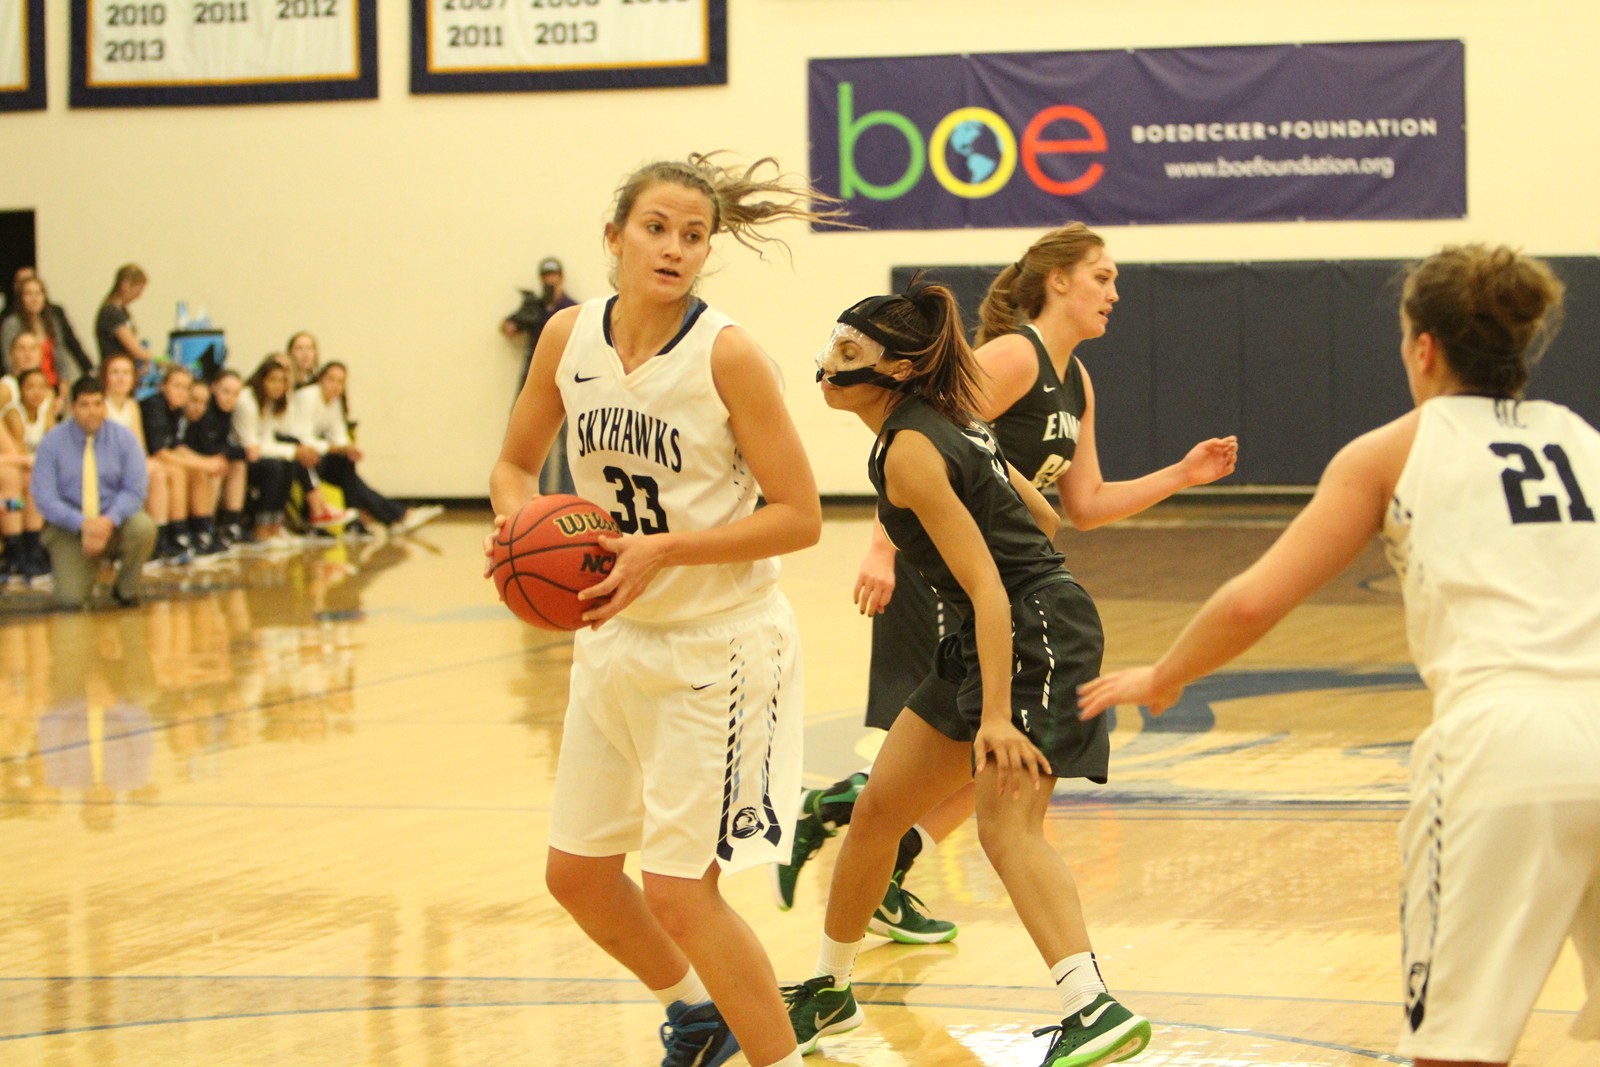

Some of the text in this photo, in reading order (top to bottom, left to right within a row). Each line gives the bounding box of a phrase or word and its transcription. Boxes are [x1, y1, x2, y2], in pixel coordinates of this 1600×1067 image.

[106, 0, 338, 27] 2010 2011 2012
[447, 21, 599, 48] 2011 2013
[105, 40, 166, 63] 2013
[836, 81, 1109, 201] boe
[1163, 154, 1396, 180] www.boefoundation.org
[577, 407, 682, 473] SKYHAWKS
[602, 465, 670, 536] 33
[1488, 442, 1596, 525] 21
